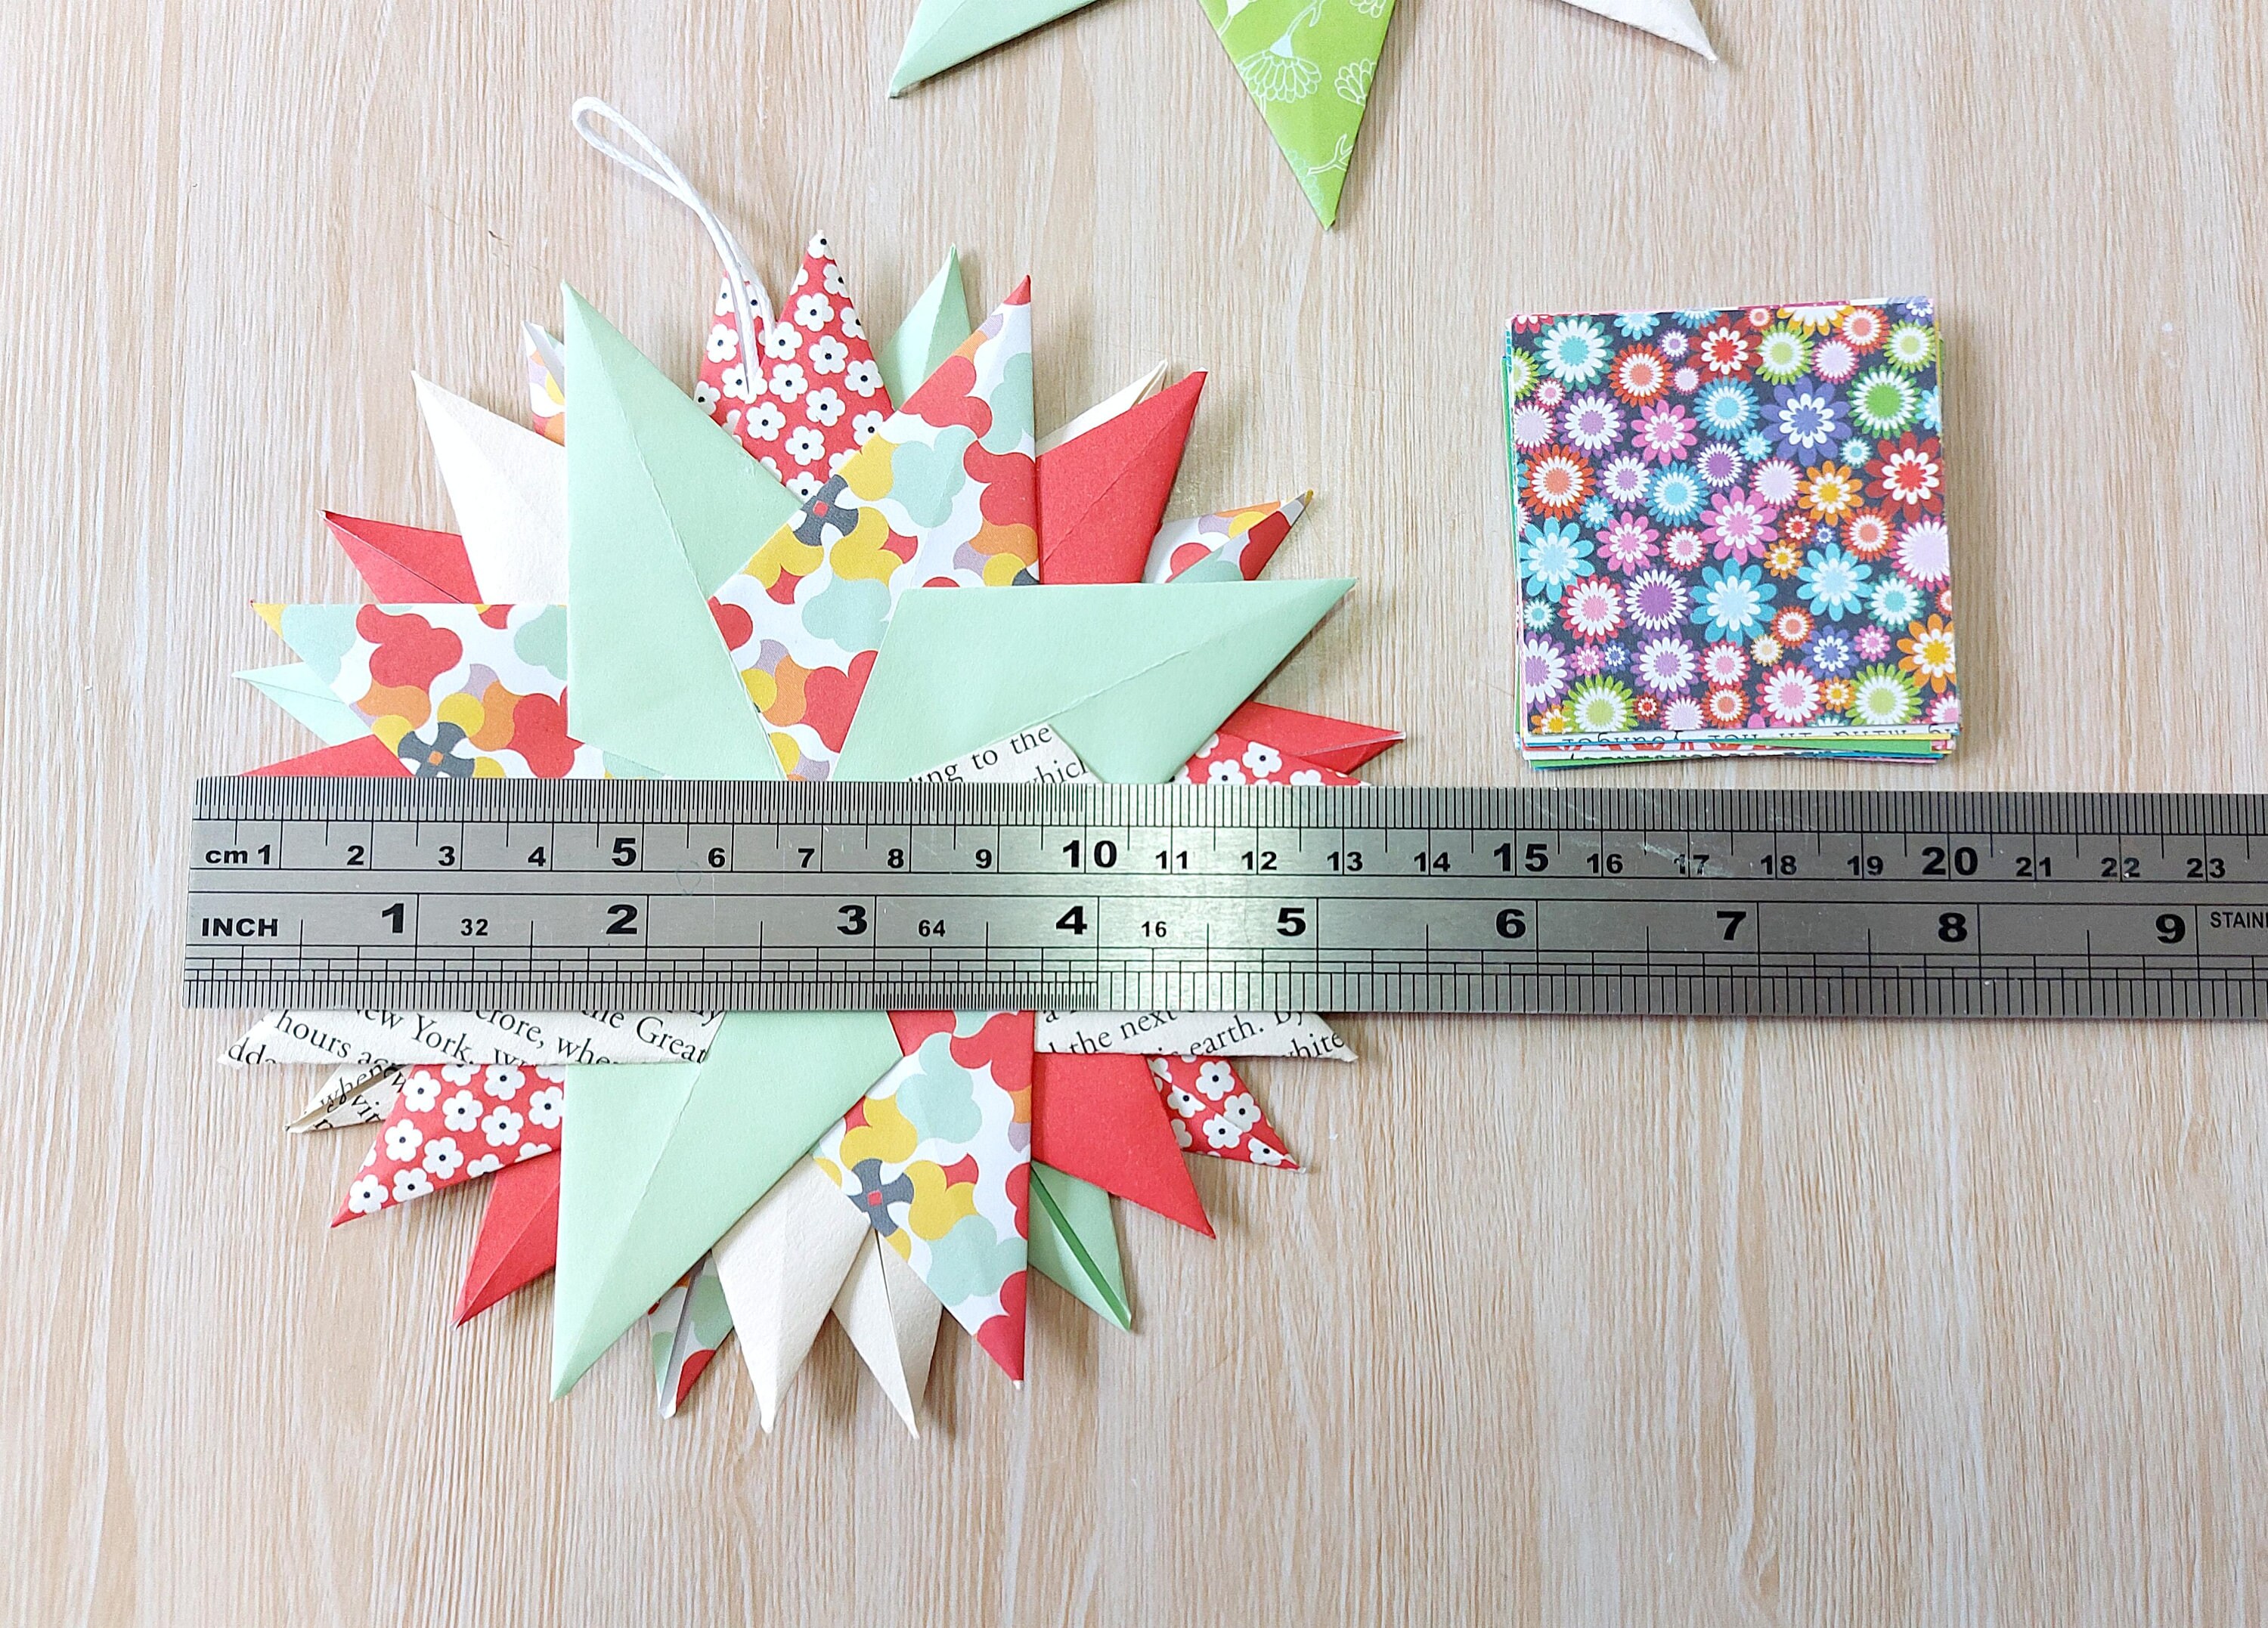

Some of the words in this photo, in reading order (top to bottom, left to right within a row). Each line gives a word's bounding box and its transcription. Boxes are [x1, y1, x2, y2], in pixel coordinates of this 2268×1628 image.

[971, 749, 997, 769] to
[1009, 726, 1052, 754] the
[206, 849, 249, 865] cm
[258, 845, 272, 865] 1
[346, 846, 365, 866] 2
[438, 846, 455, 866] 3
[528, 846, 546, 867] 4
[611, 837, 637, 867] 5
[708, 847, 726, 868] 6
[798, 848, 816, 868] 7
[888, 848, 905, 869] 8
[974, 848, 993, 869] 9
[1062, 840, 1117, 869] 10
[1155, 850, 1190, 870] 11
[1241, 851, 1278, 870] 12
[1327, 852, 1363, 872] 13
[1414, 852, 1451, 872] 14
[1493, 843, 1549, 872] 15
[1587, 853, 1623, 874] 16
[1674, 854, 1709, 874] 17
[1760, 855, 1797, 875] 18
[1847, 856, 1883, 877] 19
[1921, 846, 1978, 876] 20
[2015, 857, 2053, 877] 21
[2101, 858, 2141, 877] 22
[2186, 858, 2226, 878] 23
[201, 918, 279, 937] INCH
[382, 903, 404, 933] 1
[460, 919, 489, 936] 32
[606, 905, 639, 935] 2
[837, 905, 868, 936] 3
[917, 920, 947, 937] 64
[1055, 905, 1088, 936] 4
[1141, 921, 1167, 938] 16
[1276, 907, 1306, 936] 5
[1495, 908, 1526, 939] 6
[1715, 910, 1747, 941] 7
[1938, 912, 1968, 942] 8
[2155, 913, 2186, 943] 9
[2210, 911, 2268, 929] STAIN
[274, 1010, 352, 1058] hours
[1069, 1031, 1114, 1054] the
[1189, 1014, 1265, 1056] earth.
[1288, 1032, 1345, 1058] hite
